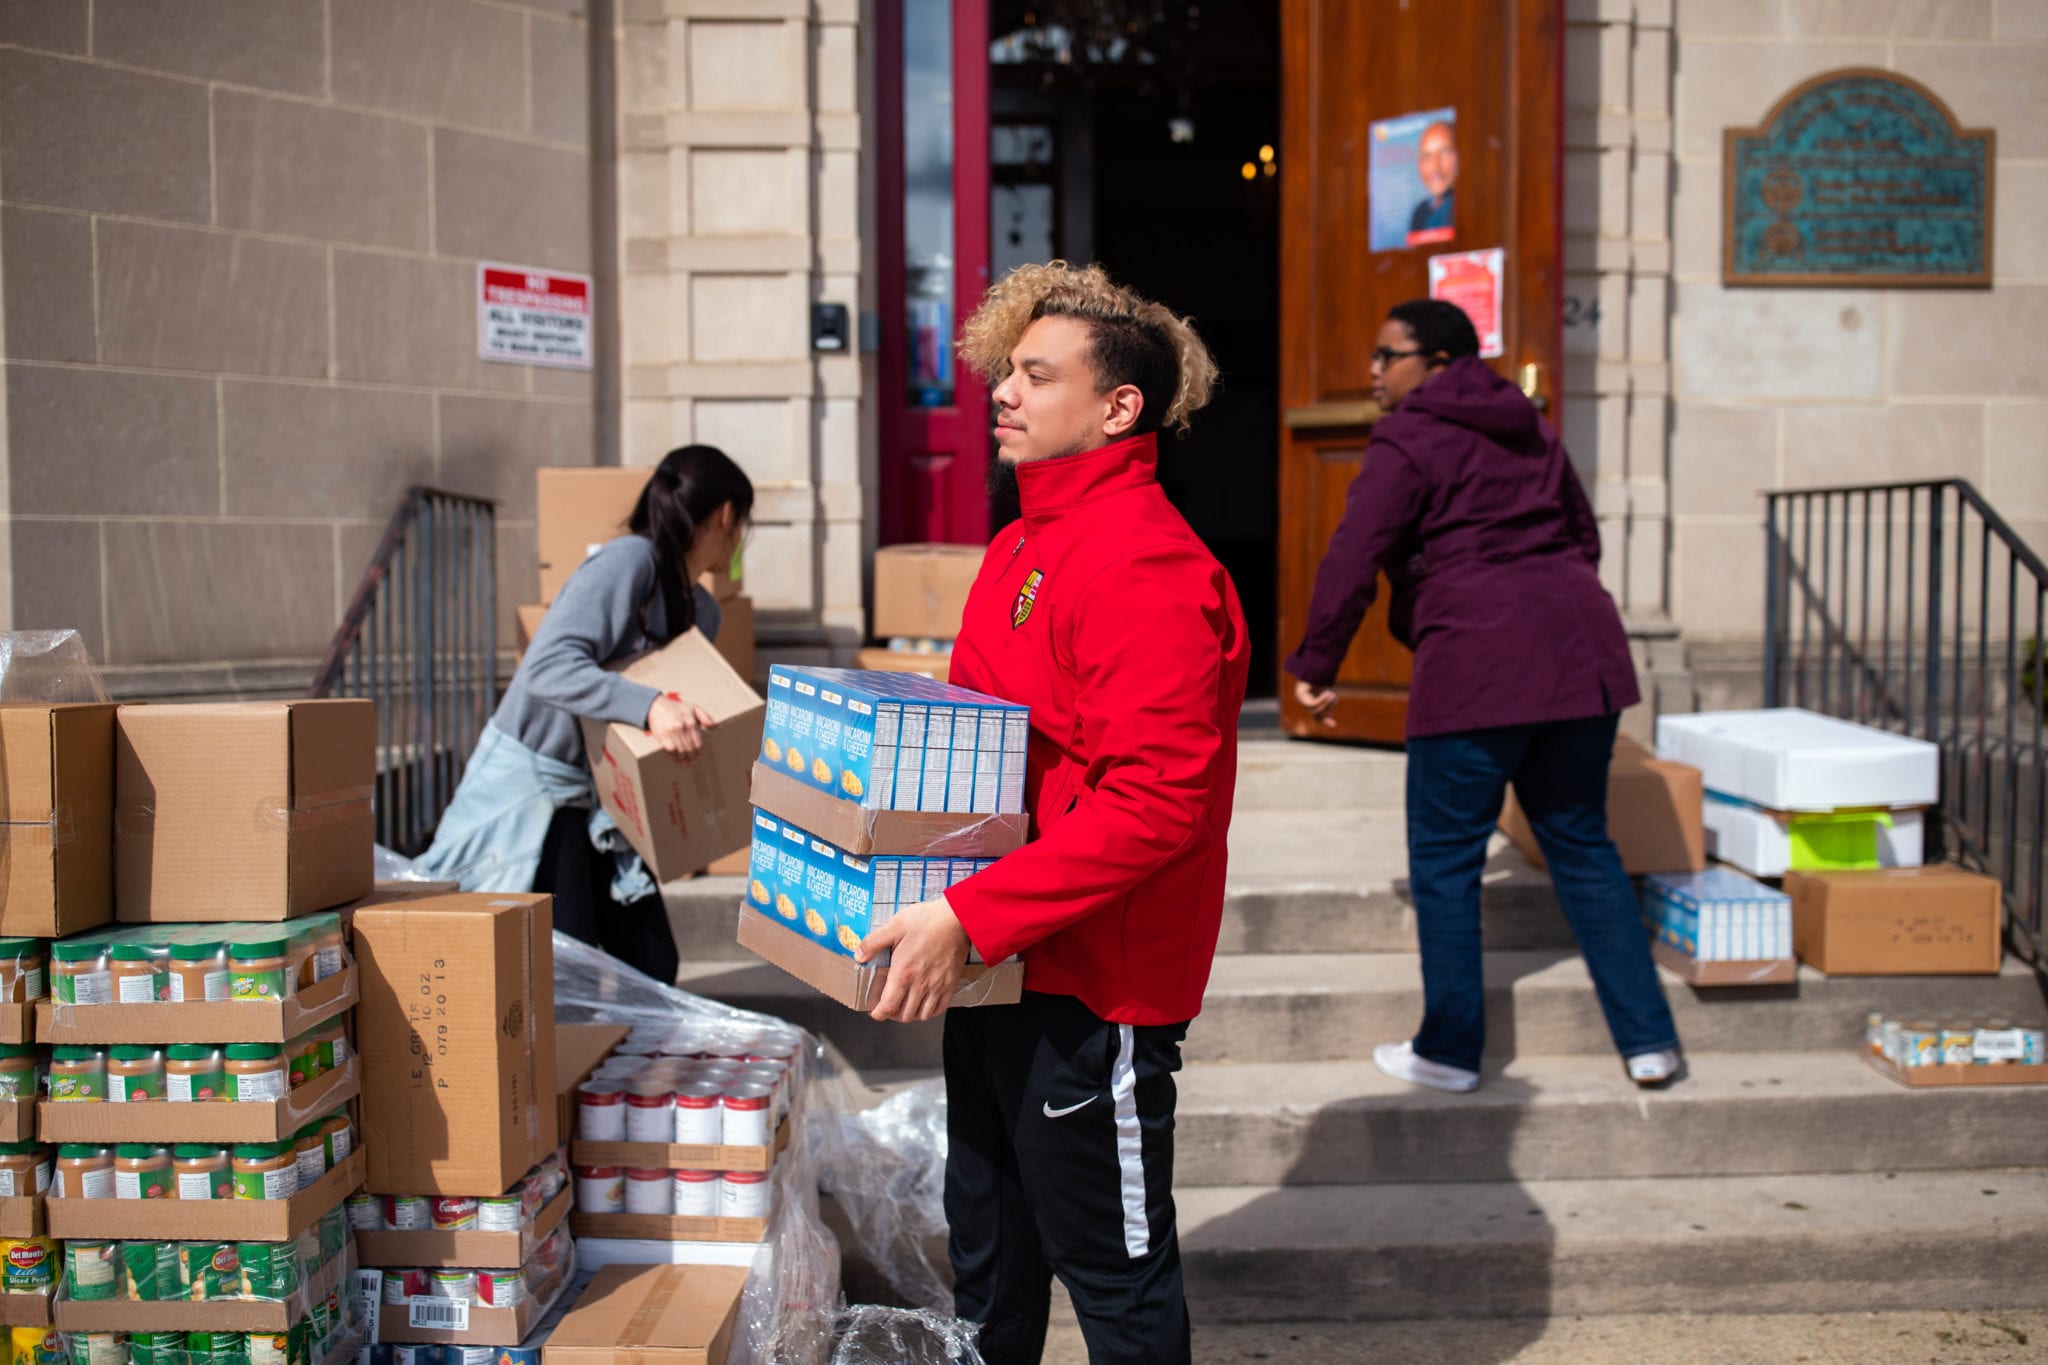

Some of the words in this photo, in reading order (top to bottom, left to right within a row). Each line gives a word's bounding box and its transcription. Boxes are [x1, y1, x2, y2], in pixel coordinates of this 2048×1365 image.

[815, 713, 841, 734] MACARONI
[818, 728, 839, 747] CHEESE
[843, 724, 872, 745] MACARONI
[847, 740, 868, 758] CHEESE
[779, 850, 805, 871] MACARONI
[782, 864, 801, 885] CHEESE
[807, 863, 835, 887] MACARONI
[811, 879, 833, 900] CHEESE
[839, 878, 870, 903] MACARONI
[843, 893, 867, 916] CHEESE
[421, 973, 431, 995] OZ
[436, 994, 446, 1016] 20
[437, 1025, 448, 1056] 079
[437, 1078, 448, 1088] P
[10, 1251, 21, 1259] Del
[21, 1250, 44, 1259] Monte
